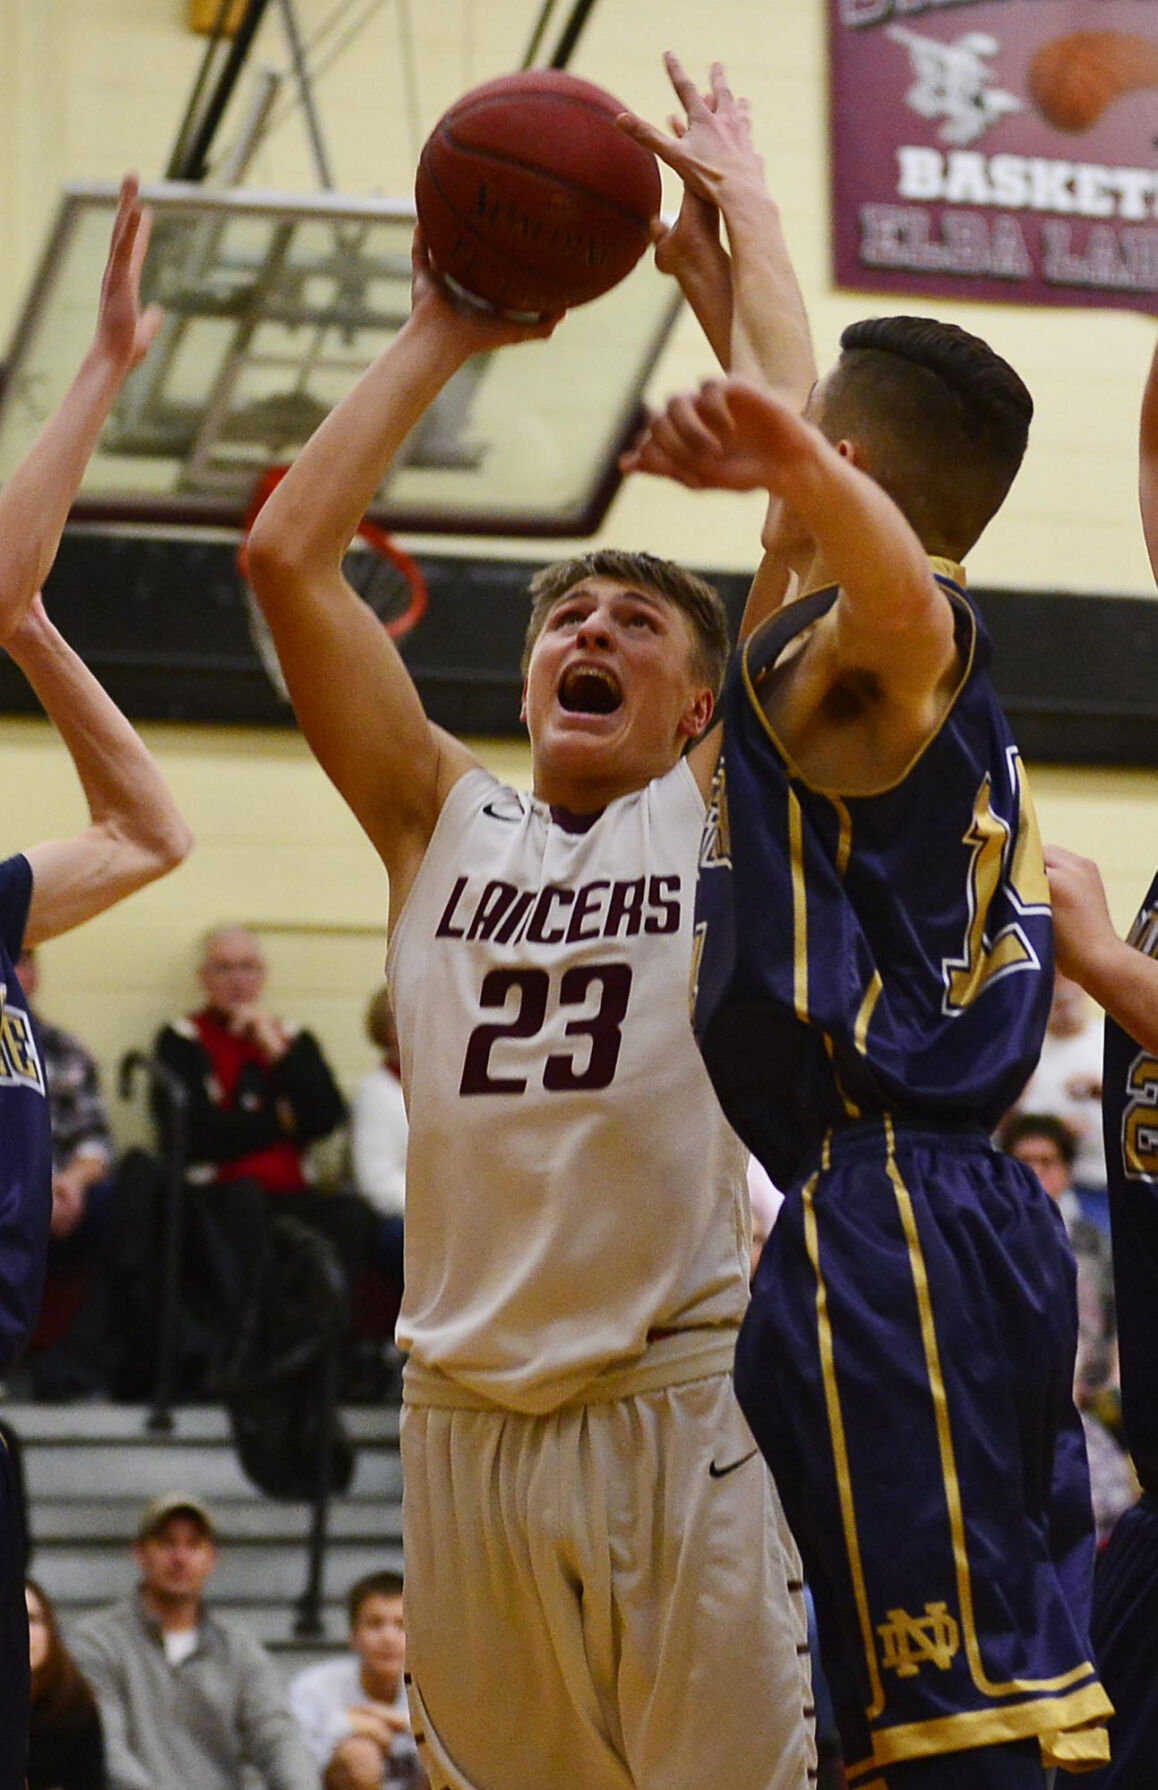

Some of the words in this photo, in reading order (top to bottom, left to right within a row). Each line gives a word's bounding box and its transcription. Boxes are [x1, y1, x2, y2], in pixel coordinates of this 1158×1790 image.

[897, 145, 1158, 221] BASKET
[859, 202, 1033, 281] ELBA
[435, 874, 682, 946] LANCERS
[459, 962, 633, 1097] 23
